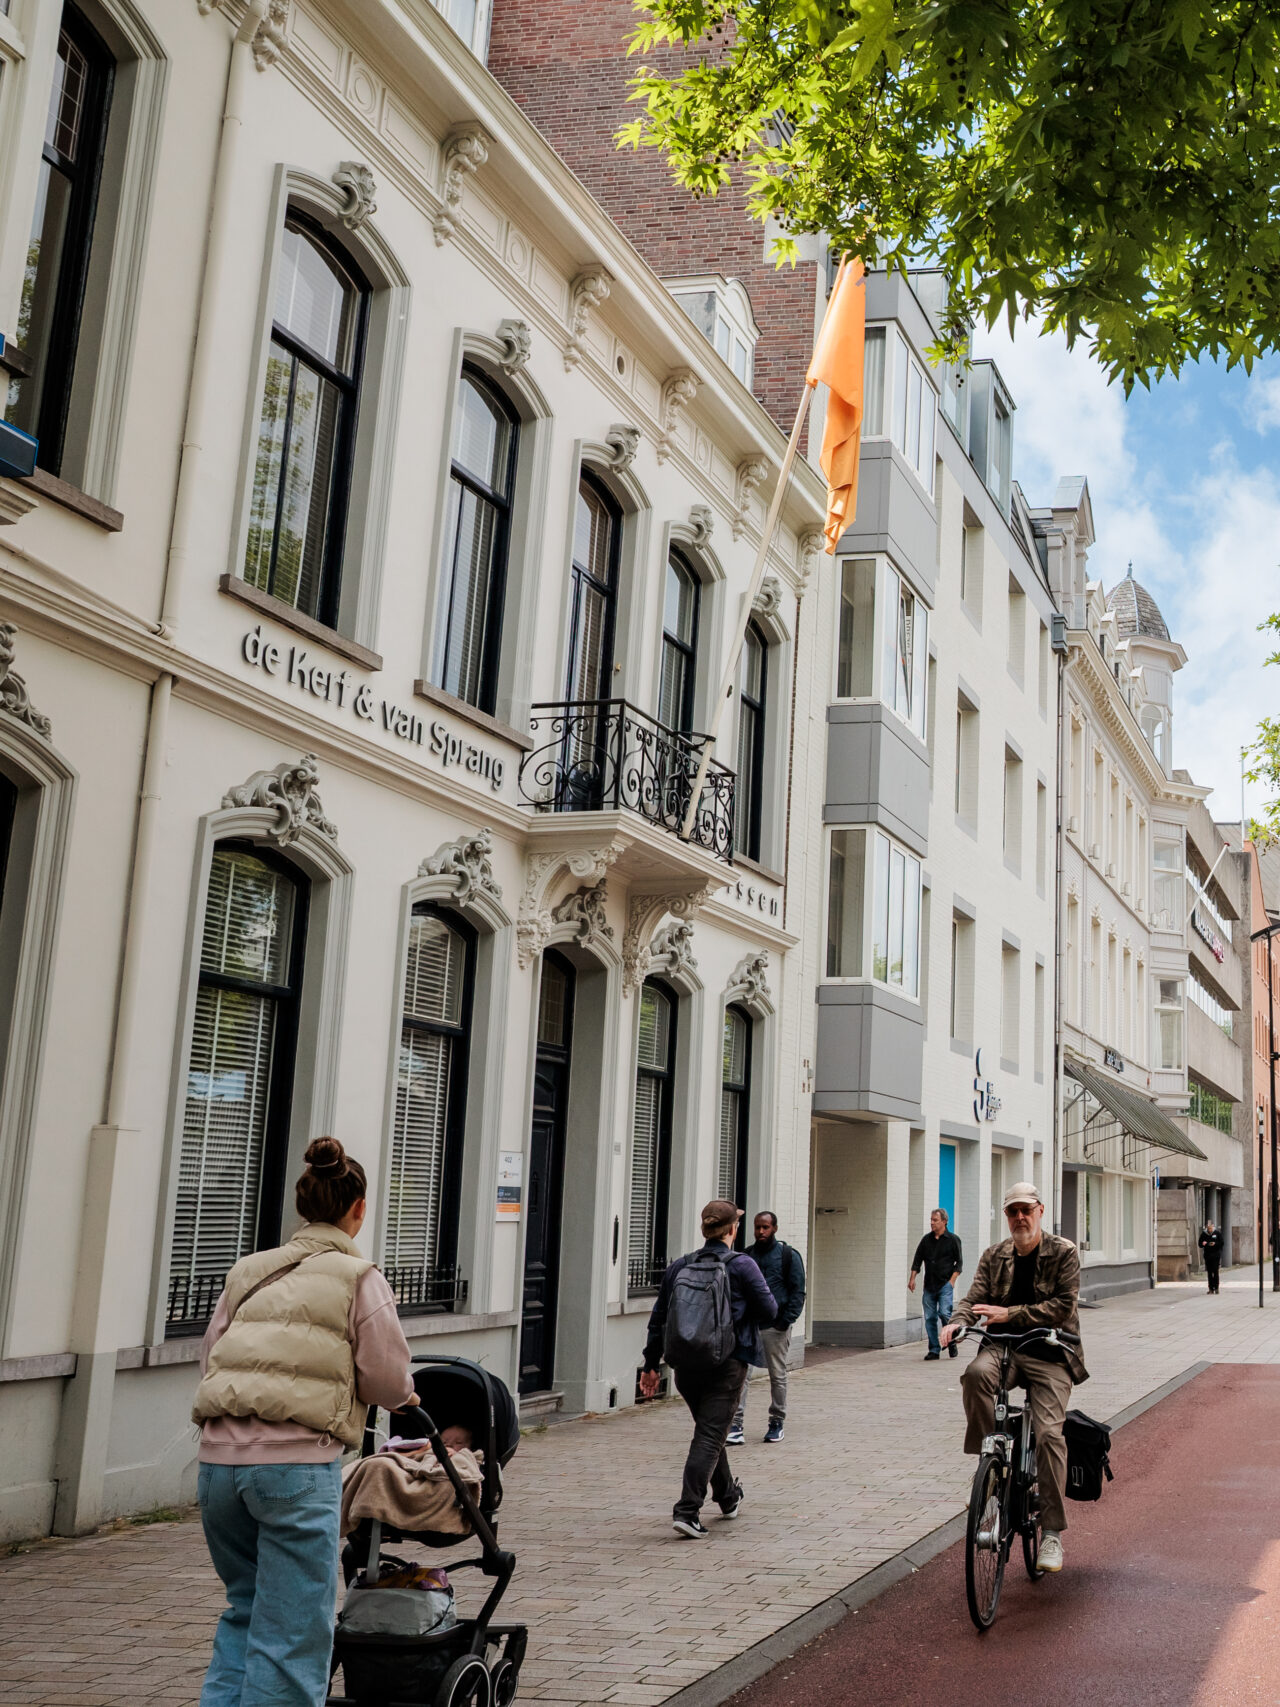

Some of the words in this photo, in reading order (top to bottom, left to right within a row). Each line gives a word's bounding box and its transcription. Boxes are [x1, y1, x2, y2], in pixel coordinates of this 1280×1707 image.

[241, 625, 281, 676] de
[353, 684, 376, 723] &
[381, 700, 424, 746] van
[430, 721, 505, 792] Sprang
